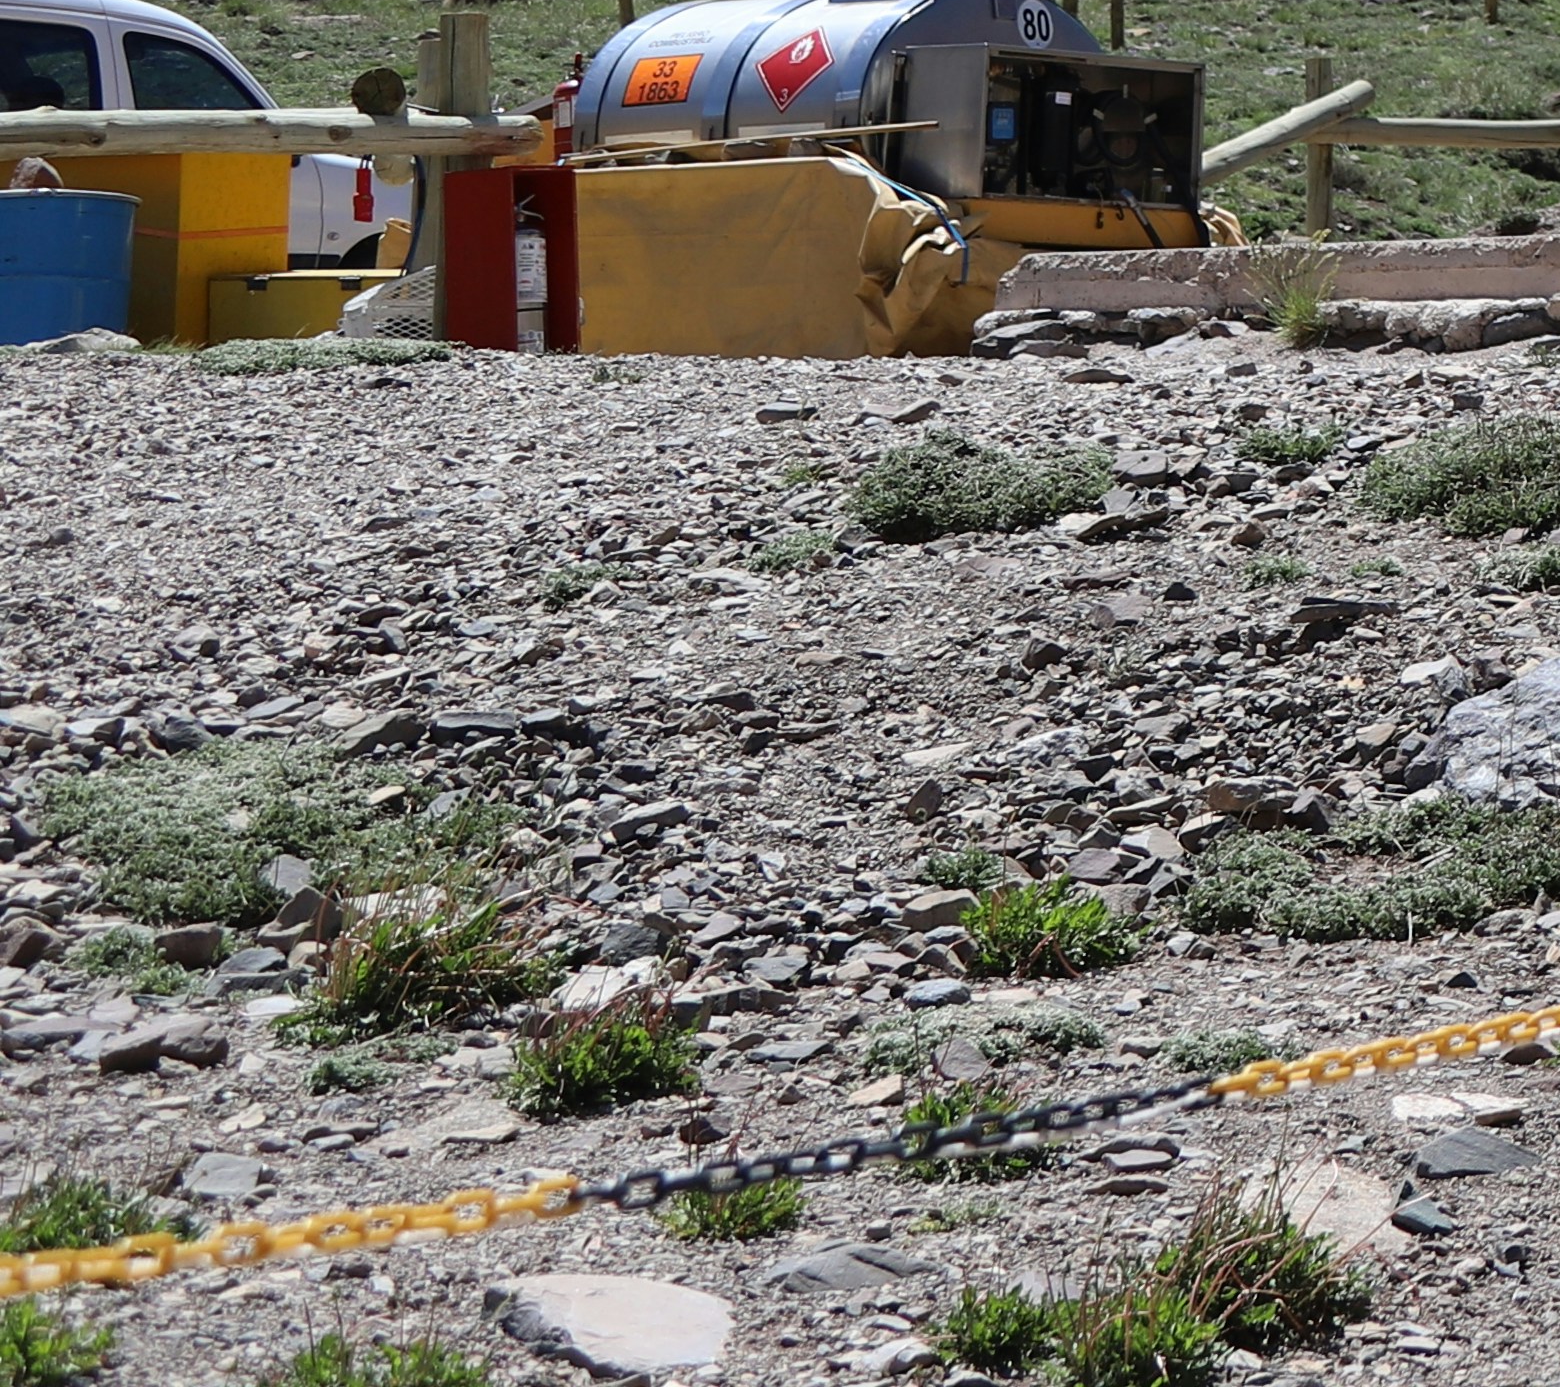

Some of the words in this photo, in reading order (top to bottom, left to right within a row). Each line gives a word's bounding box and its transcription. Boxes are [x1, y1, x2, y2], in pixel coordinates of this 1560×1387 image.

[1023, 8, 1050, 41] 80
[653, 60, 677, 78] 33
[639, 80, 679, 101] 1863
[780, 88, 788, 102] 3
